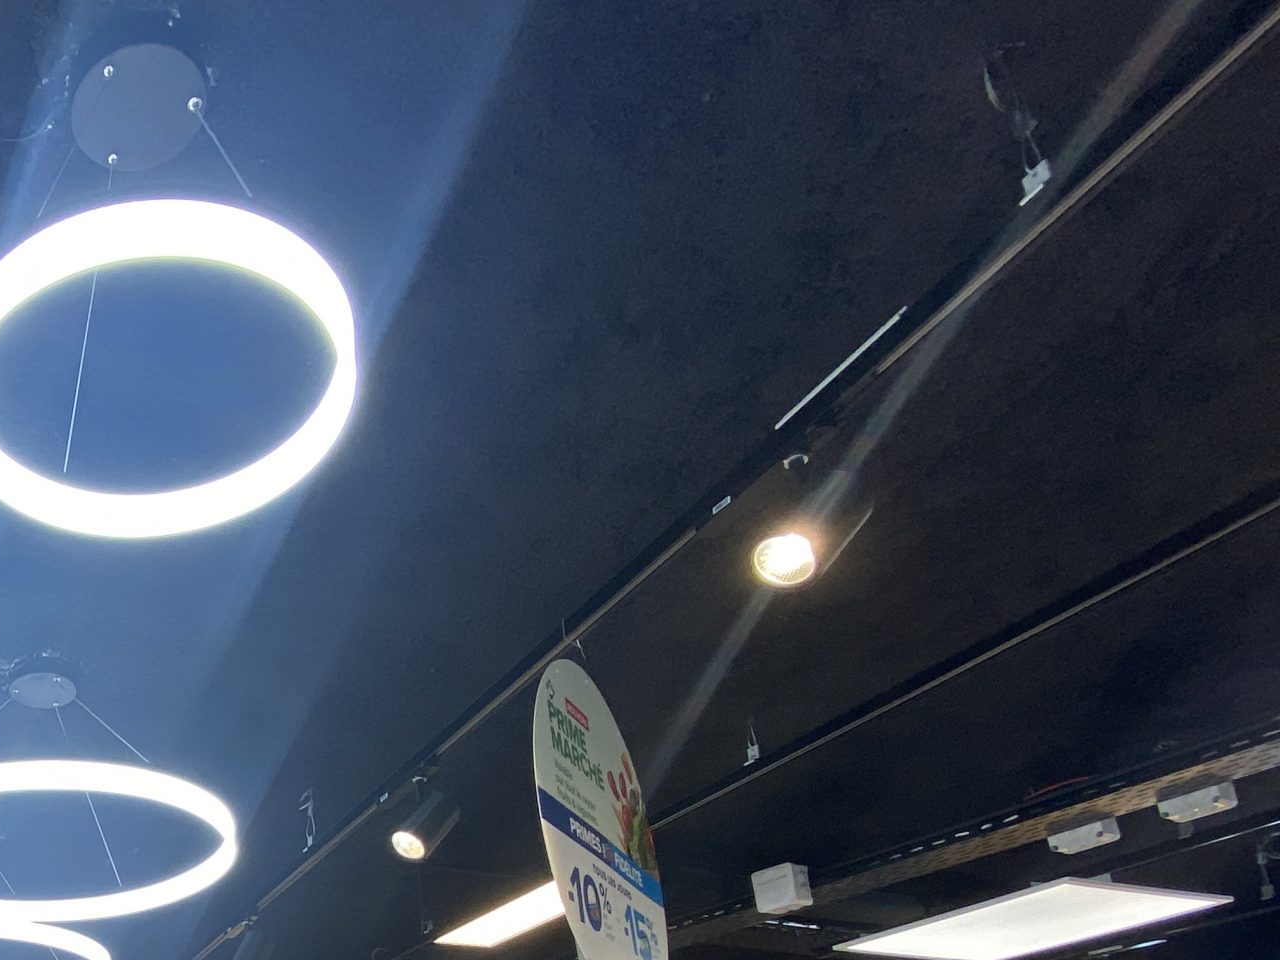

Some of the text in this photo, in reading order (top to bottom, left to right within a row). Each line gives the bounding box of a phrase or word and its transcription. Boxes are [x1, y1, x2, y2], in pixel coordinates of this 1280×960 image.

[547, 700, 588, 756] PRIME
[550, 725, 605, 792] MARCHÉ
[570, 817, 602, 854] PRIMES
